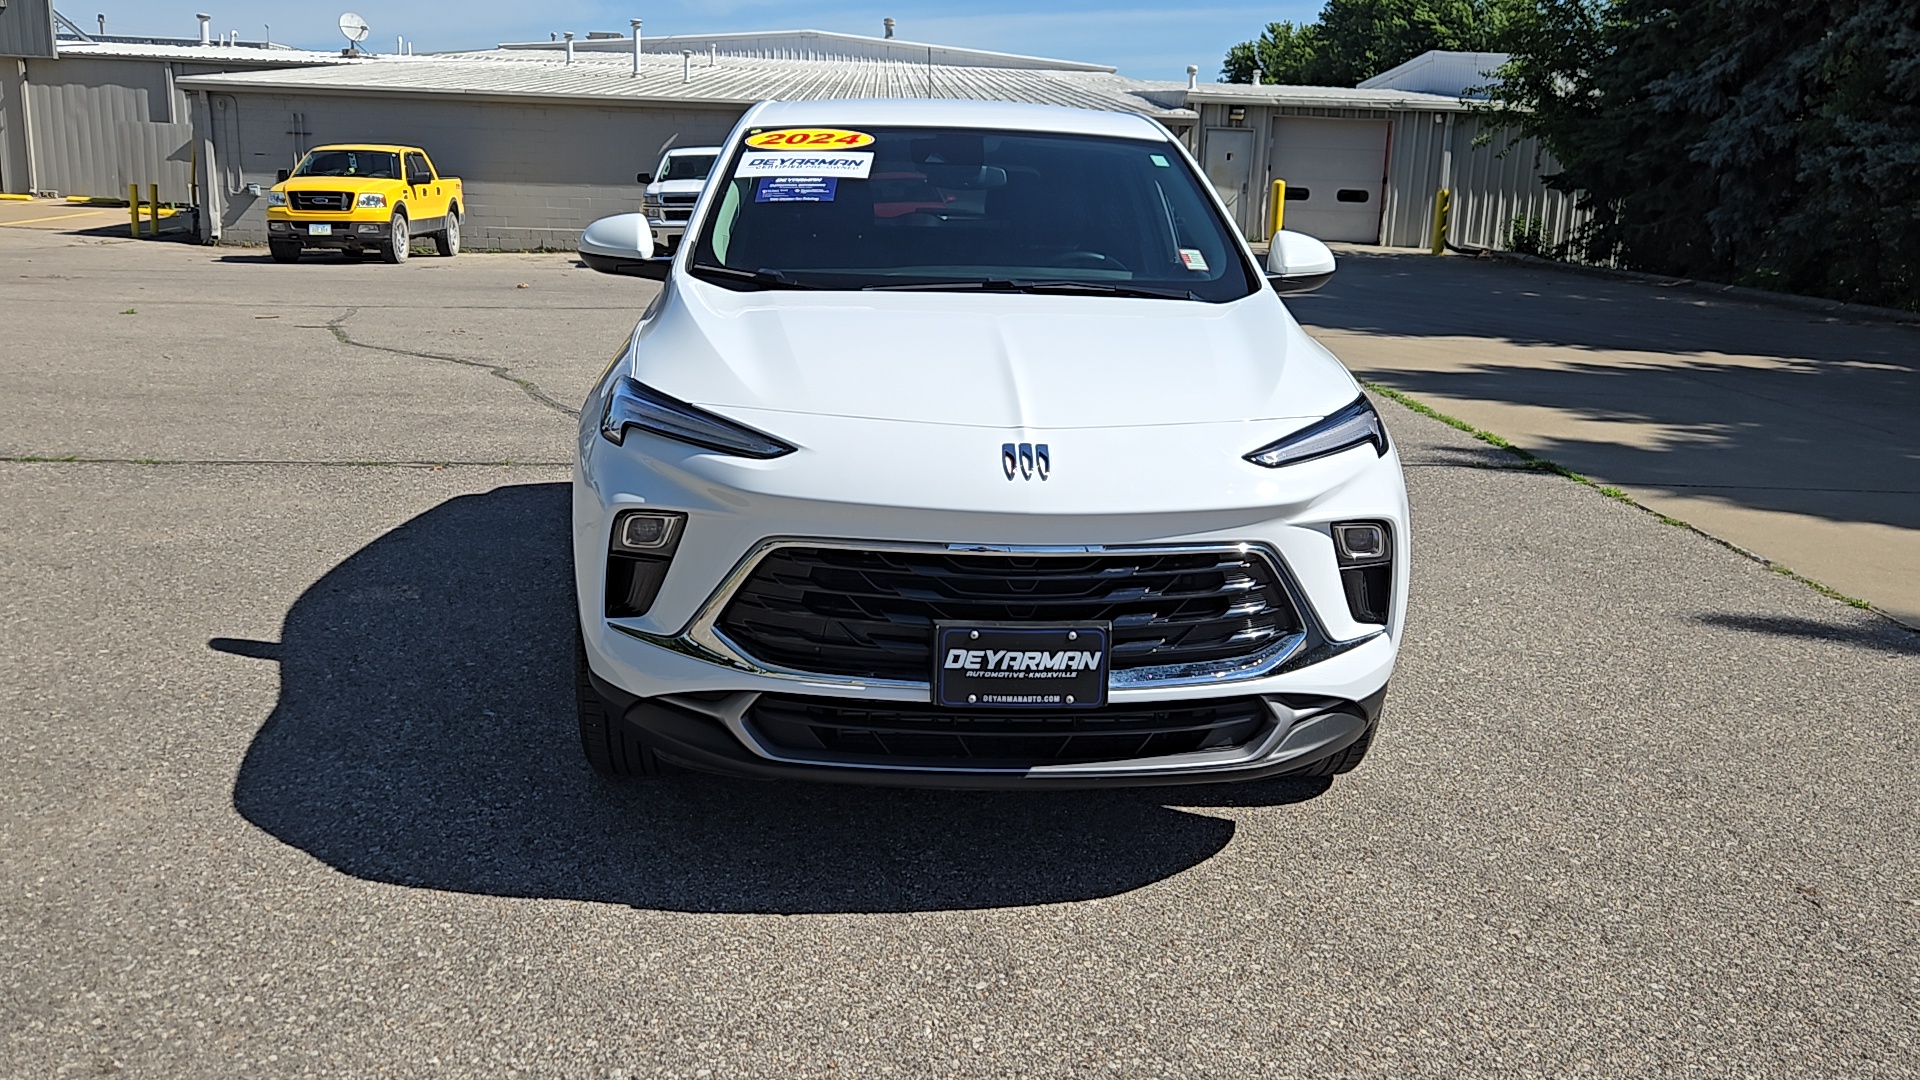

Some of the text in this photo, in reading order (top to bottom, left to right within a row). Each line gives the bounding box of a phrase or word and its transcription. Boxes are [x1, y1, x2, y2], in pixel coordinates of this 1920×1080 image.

[756, 133, 862, 145] 2024
[748, 158, 865, 167] DEYARMAN
[944, 648, 1103, 671] DEYARMAN
[966, 670, 1078, 679] AUTOMOTIVE-KNOXVILLE
[982, 694, 1061, 703] DEYARMANAUTO.COM
